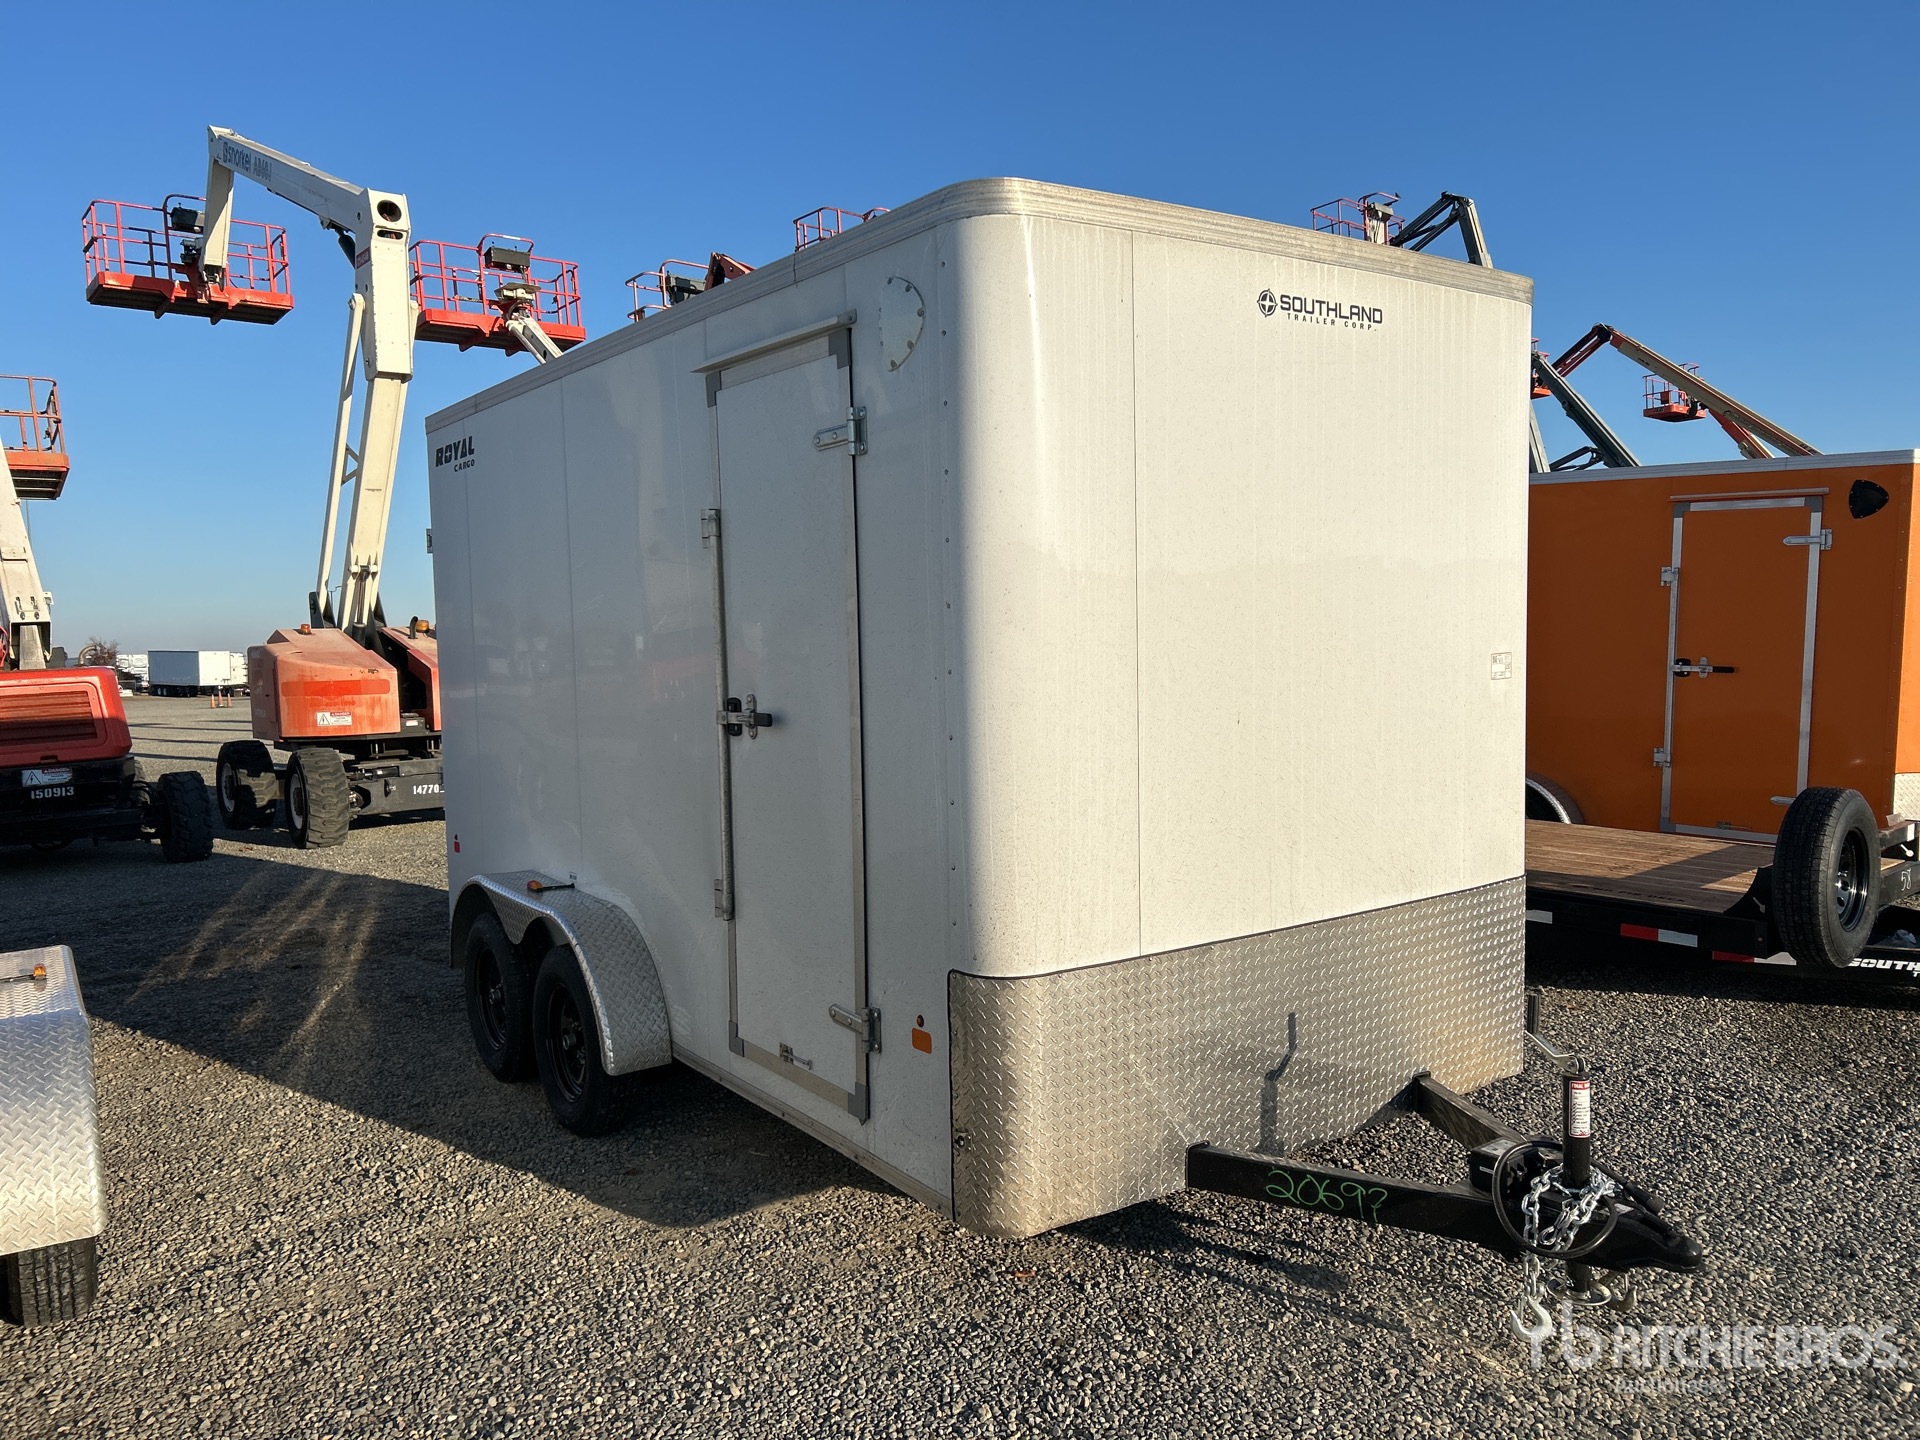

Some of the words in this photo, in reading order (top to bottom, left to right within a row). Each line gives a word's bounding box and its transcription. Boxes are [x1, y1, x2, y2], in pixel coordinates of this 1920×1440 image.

[1280, 294, 1383, 324] SOUTHLAND
[1287, 312, 1336, 326] TRAILER
[1344, 321, 1378, 332] CORP.
[435, 436, 475, 467] ROYAL
[453, 459, 475, 472] CARGO
[31, 786, 75, 799] 150913
[412, 784, 445, 795] 14770
